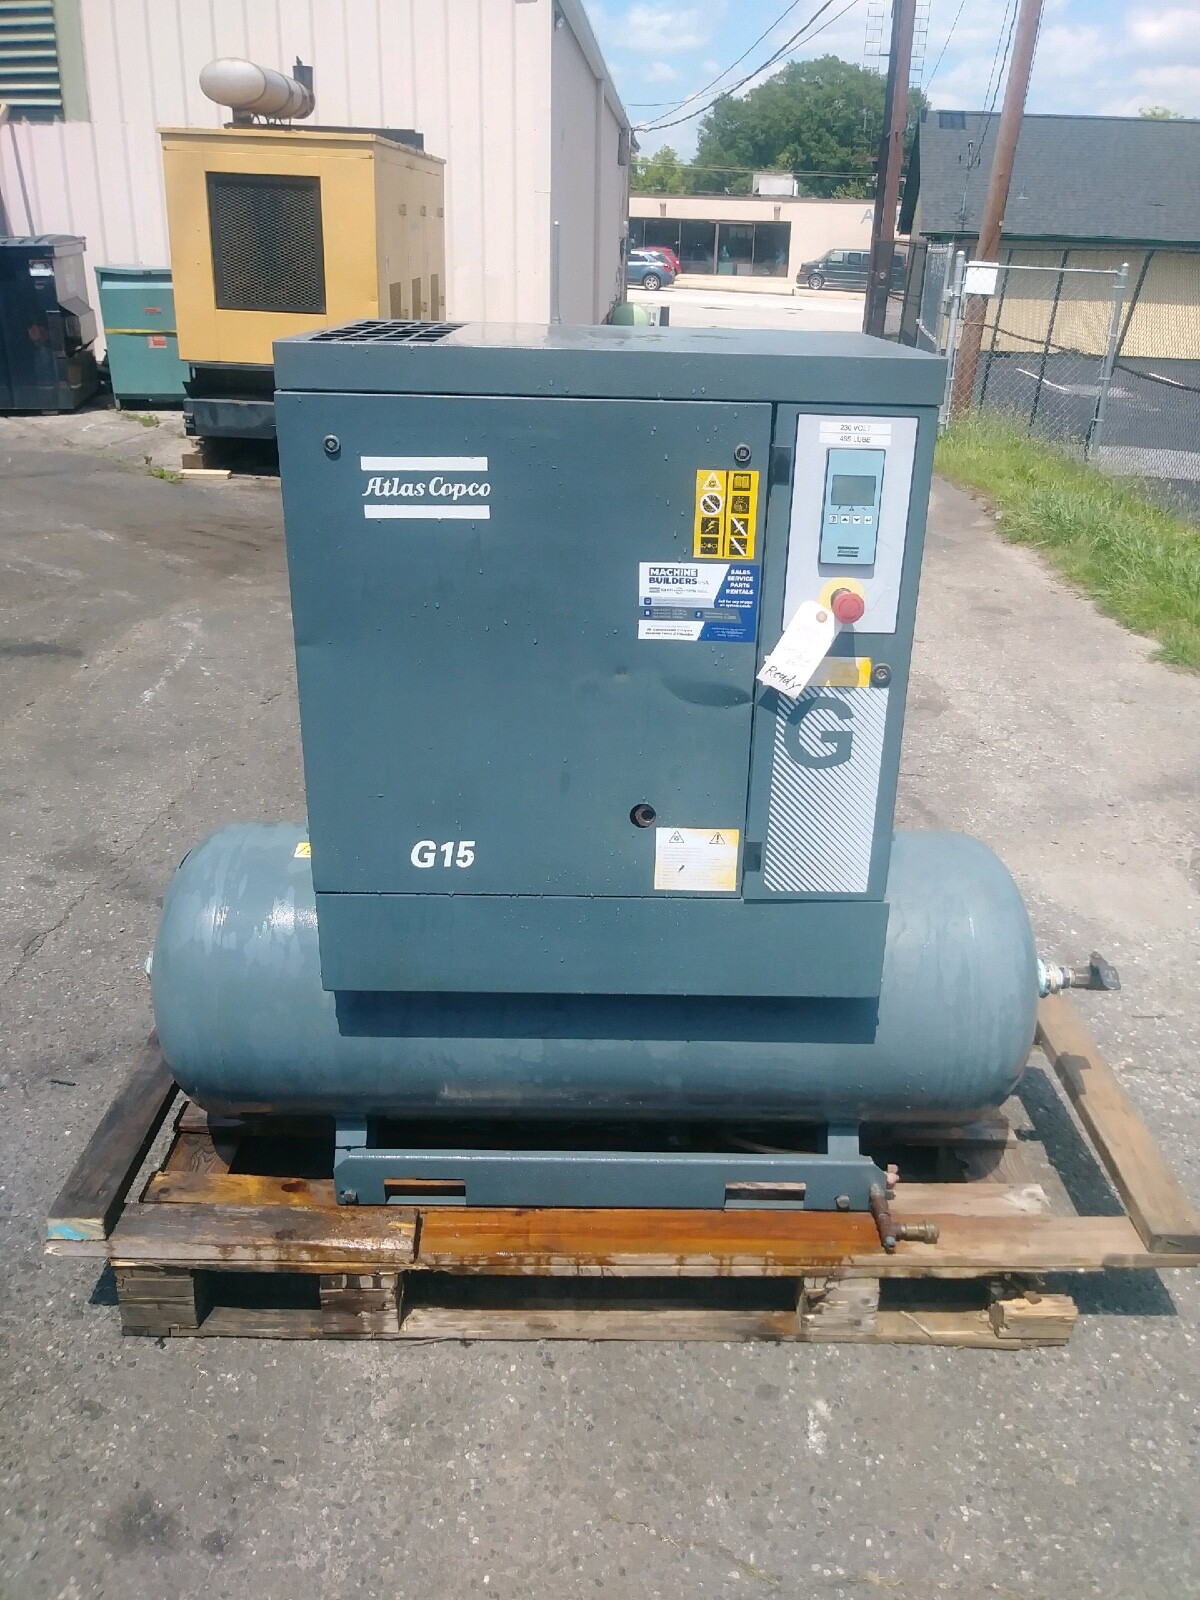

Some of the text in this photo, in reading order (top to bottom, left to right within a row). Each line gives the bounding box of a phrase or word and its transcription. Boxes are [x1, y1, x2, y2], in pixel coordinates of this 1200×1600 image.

[853, 424, 872, 432] VOLT
[361, 476, 491, 500] Atlas Copco
[649, 568, 698, 577] MACHINE
[765, 665, 802, 690] Ready
[783, 696, 854, 769] G
[410, 840, 476, 868] G15
